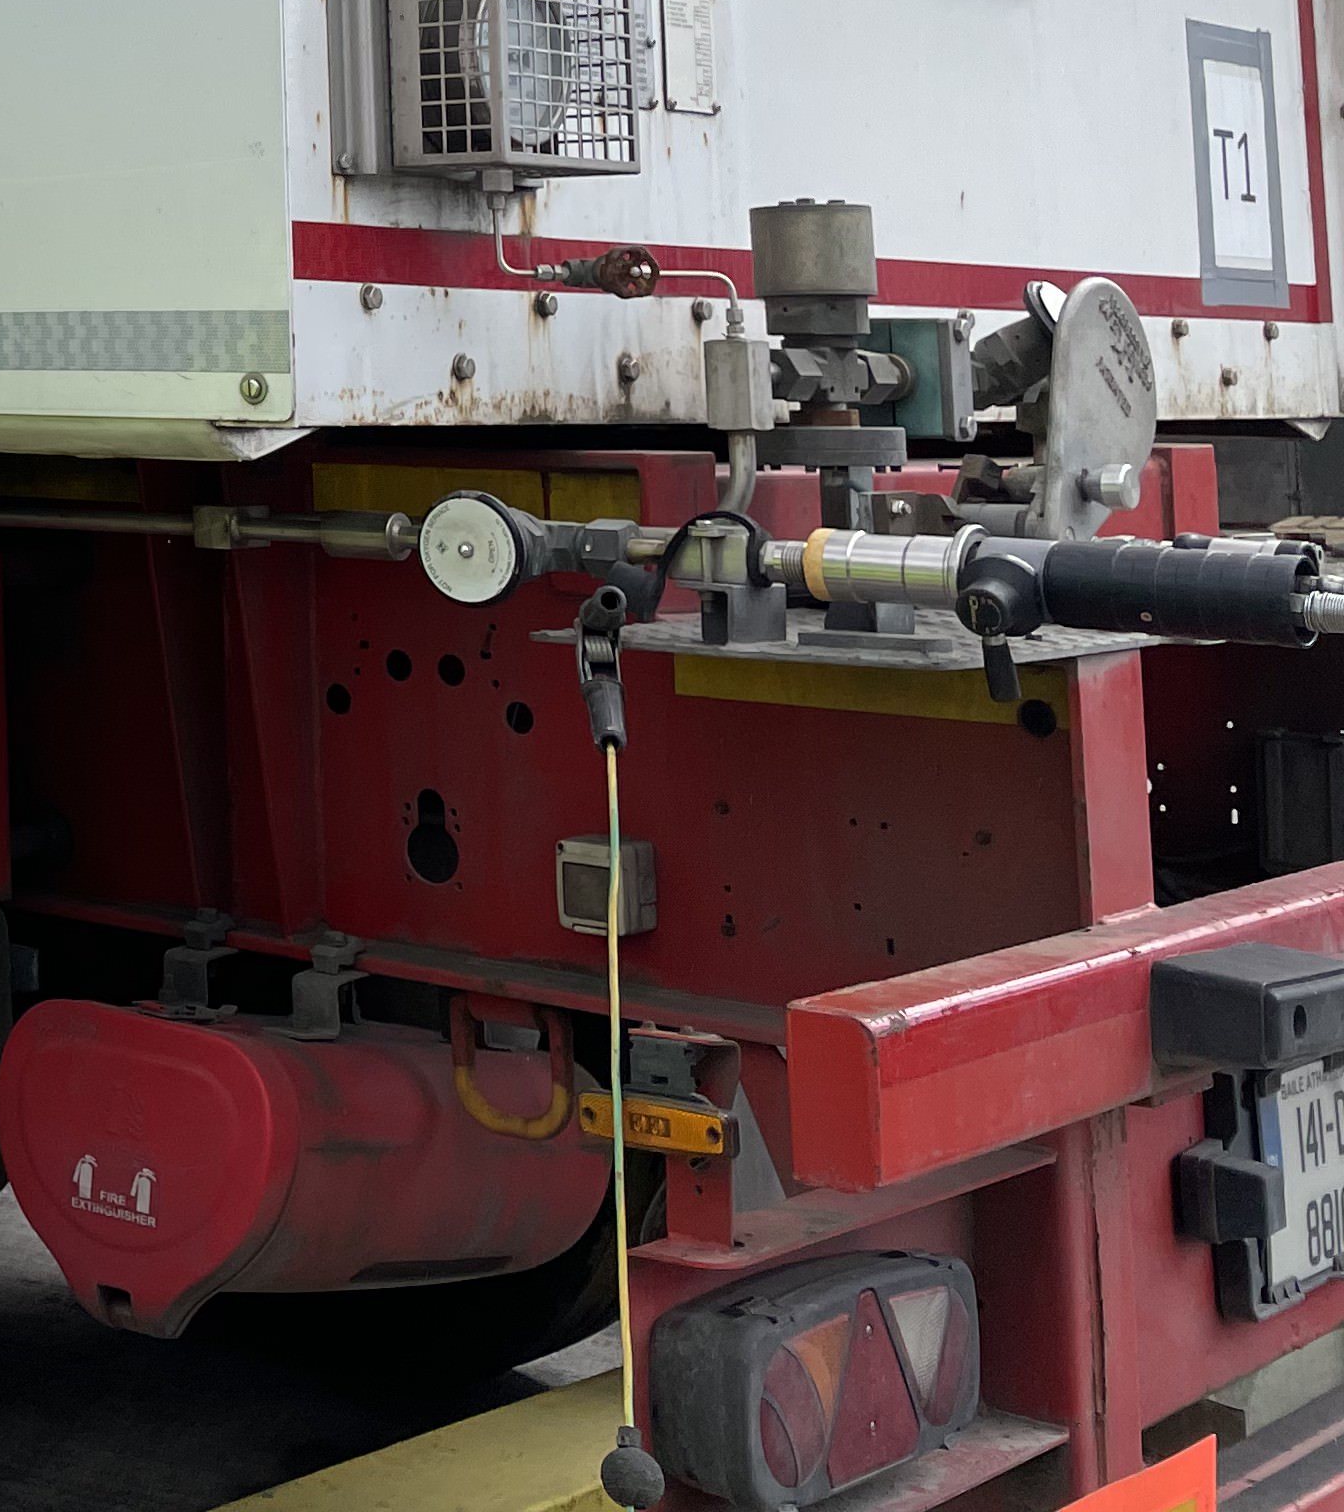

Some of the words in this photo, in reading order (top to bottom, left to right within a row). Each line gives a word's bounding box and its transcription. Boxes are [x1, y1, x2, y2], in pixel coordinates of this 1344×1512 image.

[1212, 128, 1257, 203] T1
[71, 1196, 157, 1229] EXTINGUISHER
[99, 1190, 127, 1207] FIRE
